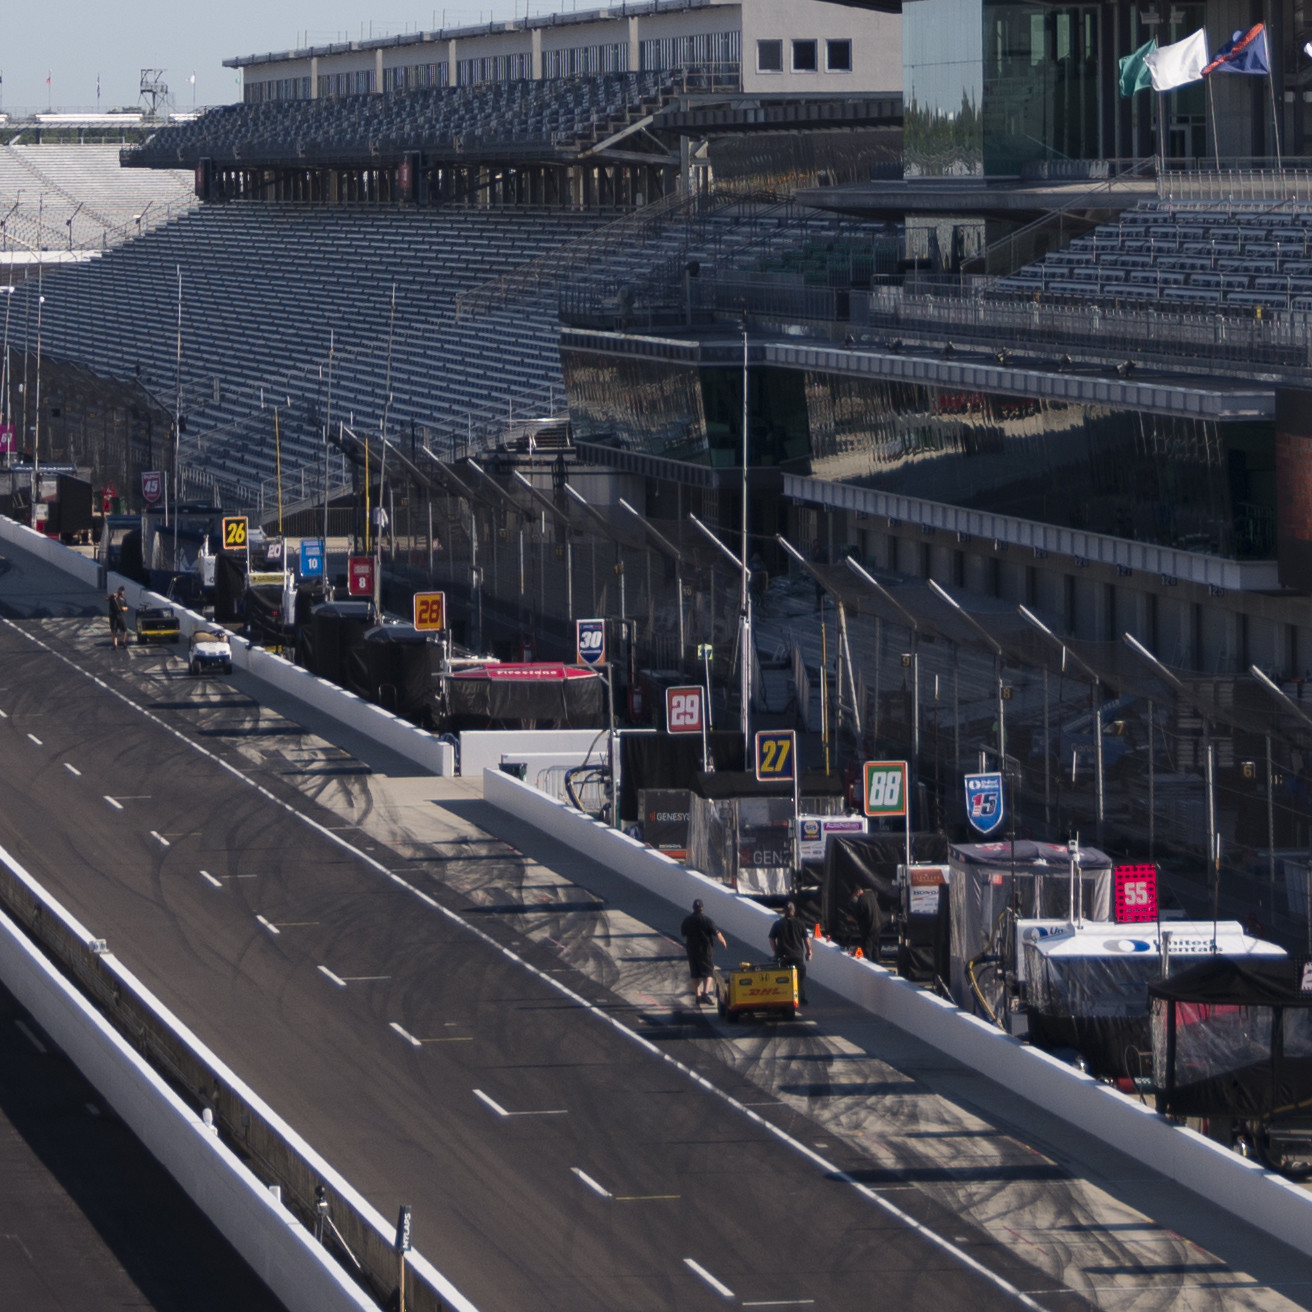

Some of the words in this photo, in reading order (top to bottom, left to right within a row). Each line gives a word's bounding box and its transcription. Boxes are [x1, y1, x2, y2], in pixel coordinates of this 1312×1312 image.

[144, 480, 158, 492] 45
[227, 523, 245, 544] 26
[267, 544, 282, 558] 20
[307, 557, 318, 570] 10
[358, 576, 367, 589] 8
[418, 599, 442, 624] 28
[579, 630, 603, 649] 30
[671, 694, 700, 726] 29
[760, 740, 791, 773] 27
[869, 771, 902, 806] 88
[971, 791, 999, 817] 15
[1124, 882, 1149, 906] 55
